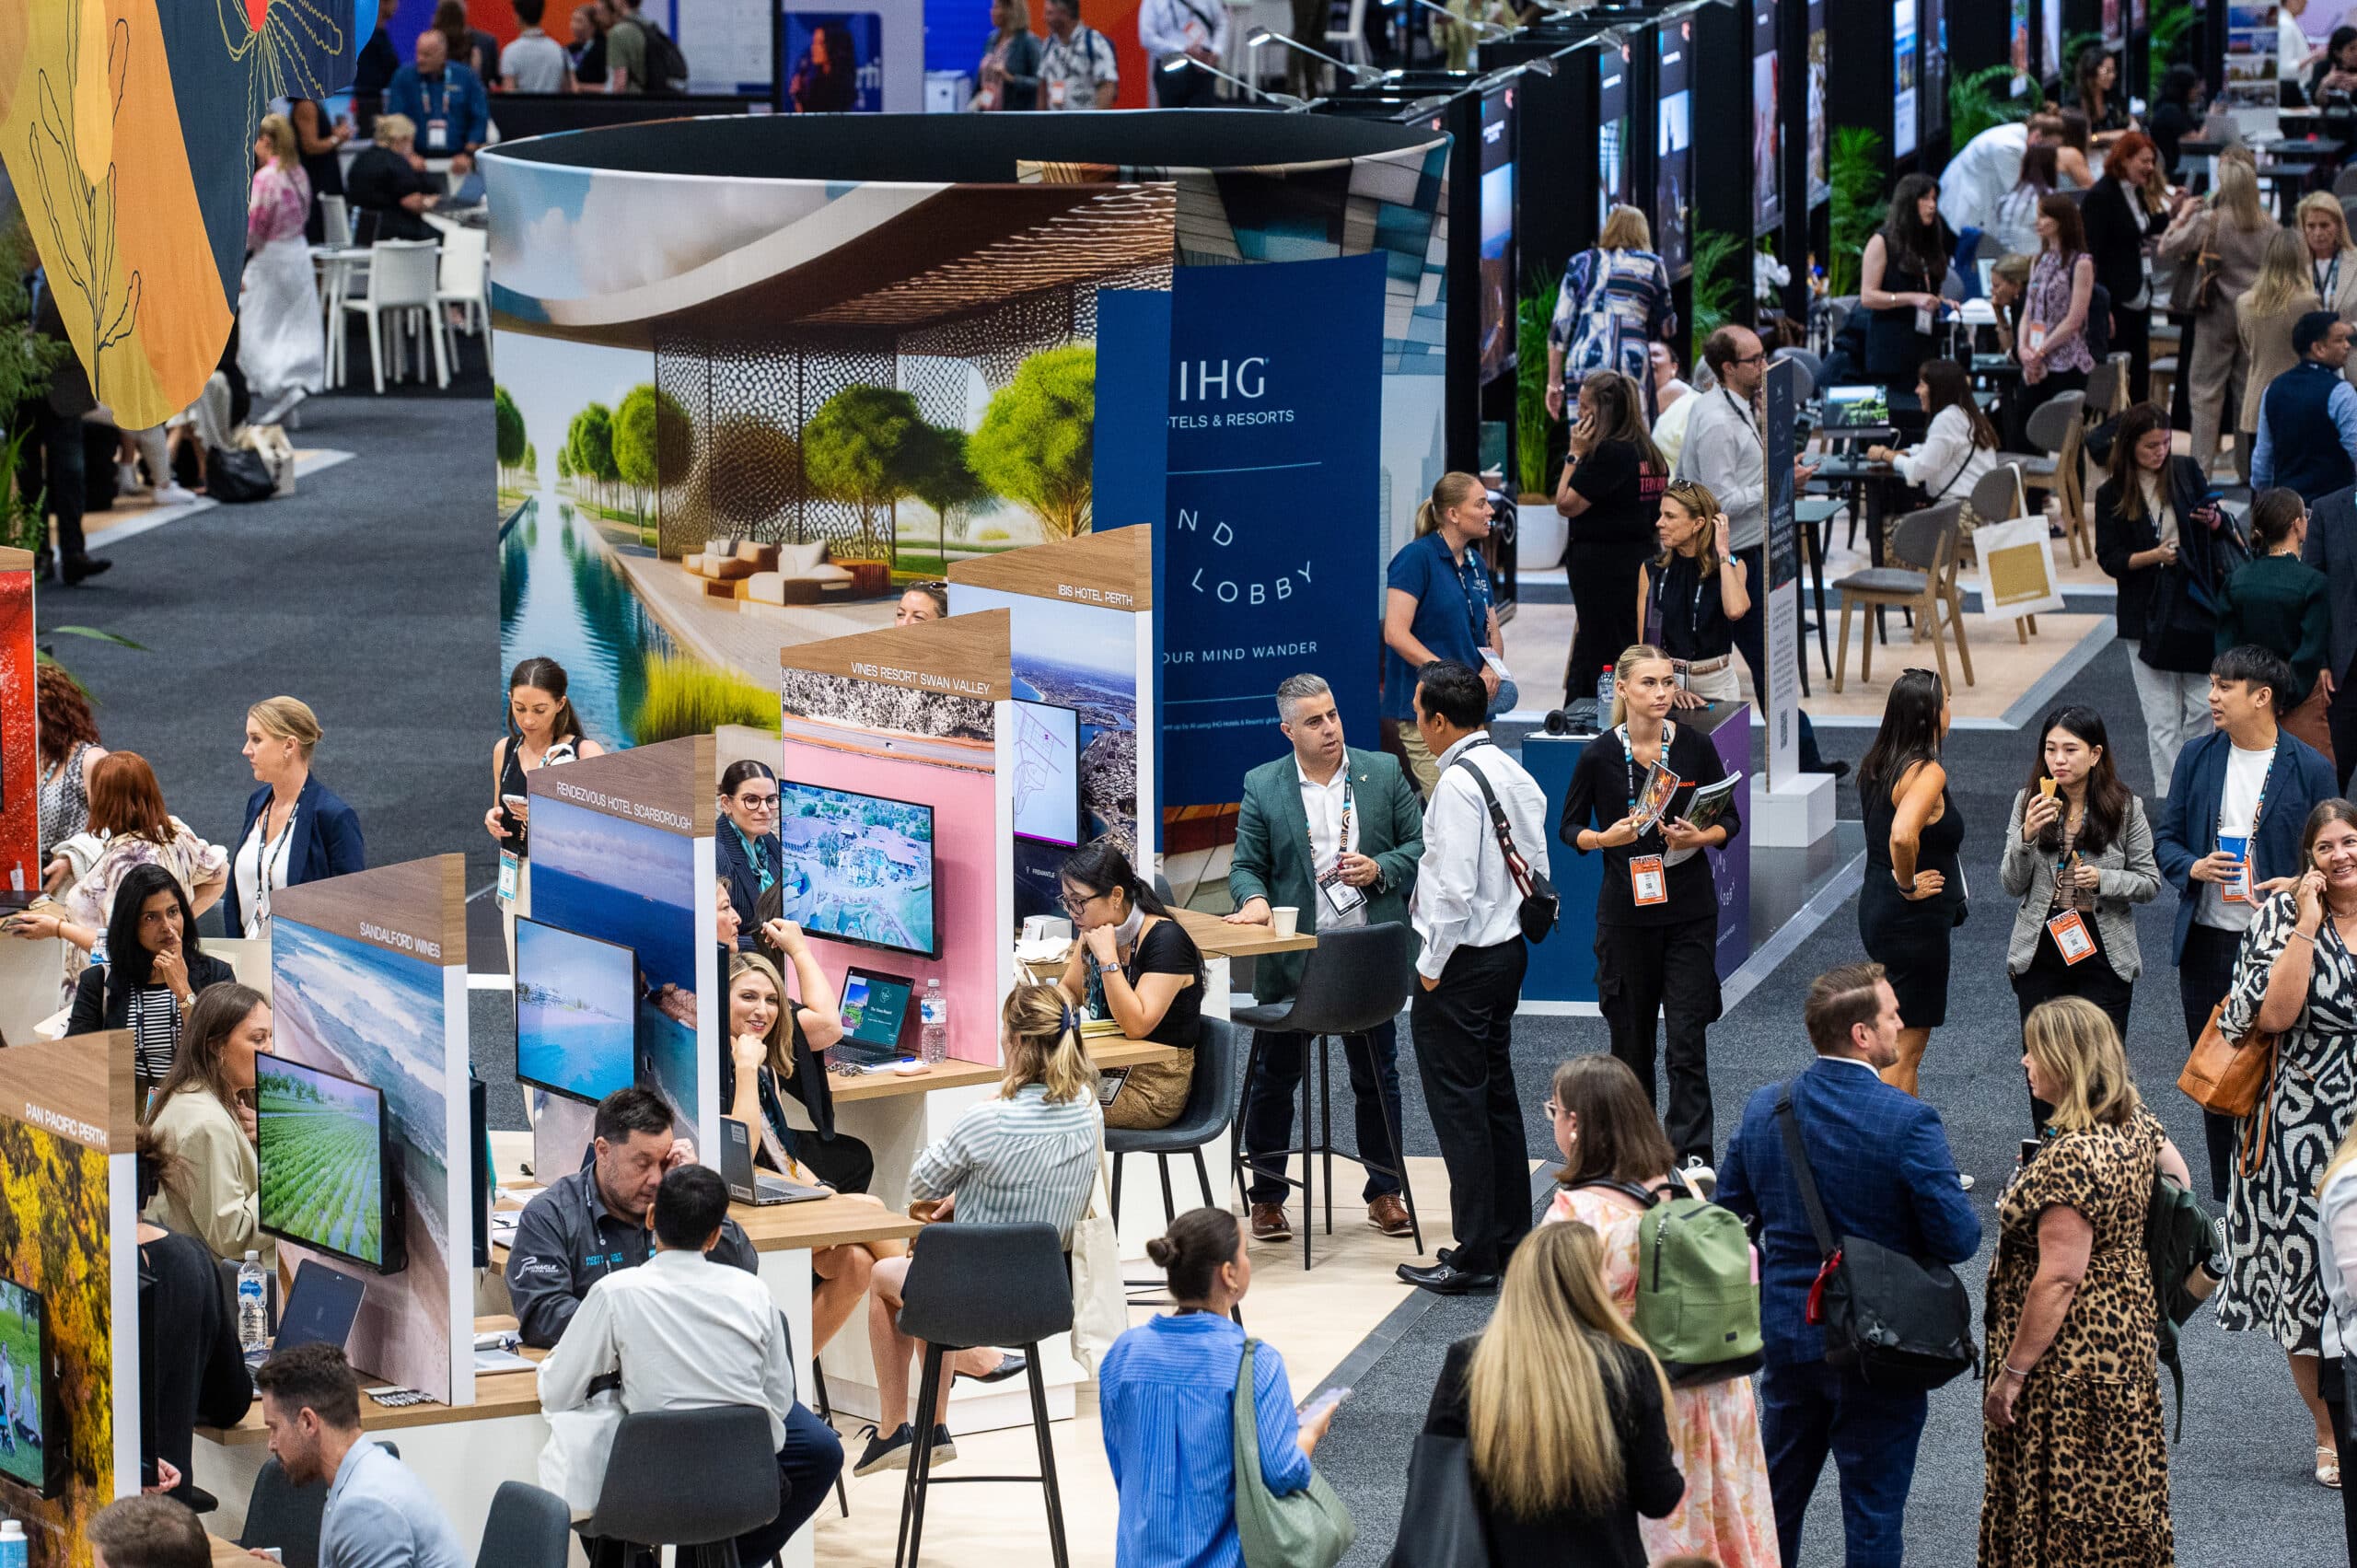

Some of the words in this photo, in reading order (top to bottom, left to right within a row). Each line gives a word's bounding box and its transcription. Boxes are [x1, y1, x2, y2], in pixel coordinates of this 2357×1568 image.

[1180, 357, 1265, 401] IHG
[1167, 415, 1208, 429] TELS
[1213, 414, 1222, 427] &
[1226, 410, 1295, 426] RESORTS
[1058, 584, 1073, 597] IBIS
[1074, 587, 1103, 601] HOTEL
[1105, 591, 1133, 606] PERTH
[1191, 560, 1312, 605] LOBBY
[1202, 648, 1246, 662] MIND
[1252, 642, 1318, 658] WANDER
[851, 661, 877, 678] VINES
[880, 667, 917, 684] RESORT
[920, 673, 950, 690] SWAN
[952, 678, 990, 695] VALLEY
[556, 782, 606, 807] RENDEZVOUS
[608, 796, 633, 815] HOTEL
[633, 804, 692, 830] SCARBOROUGH
[360, 922, 412, 949] SANDALFORD
[414, 937, 441, 958] WINES
[26, 1102, 44, 1123] PAN
[45, 1109, 77, 1136] PACIFIC
[78, 1122, 107, 1147] PERTH
